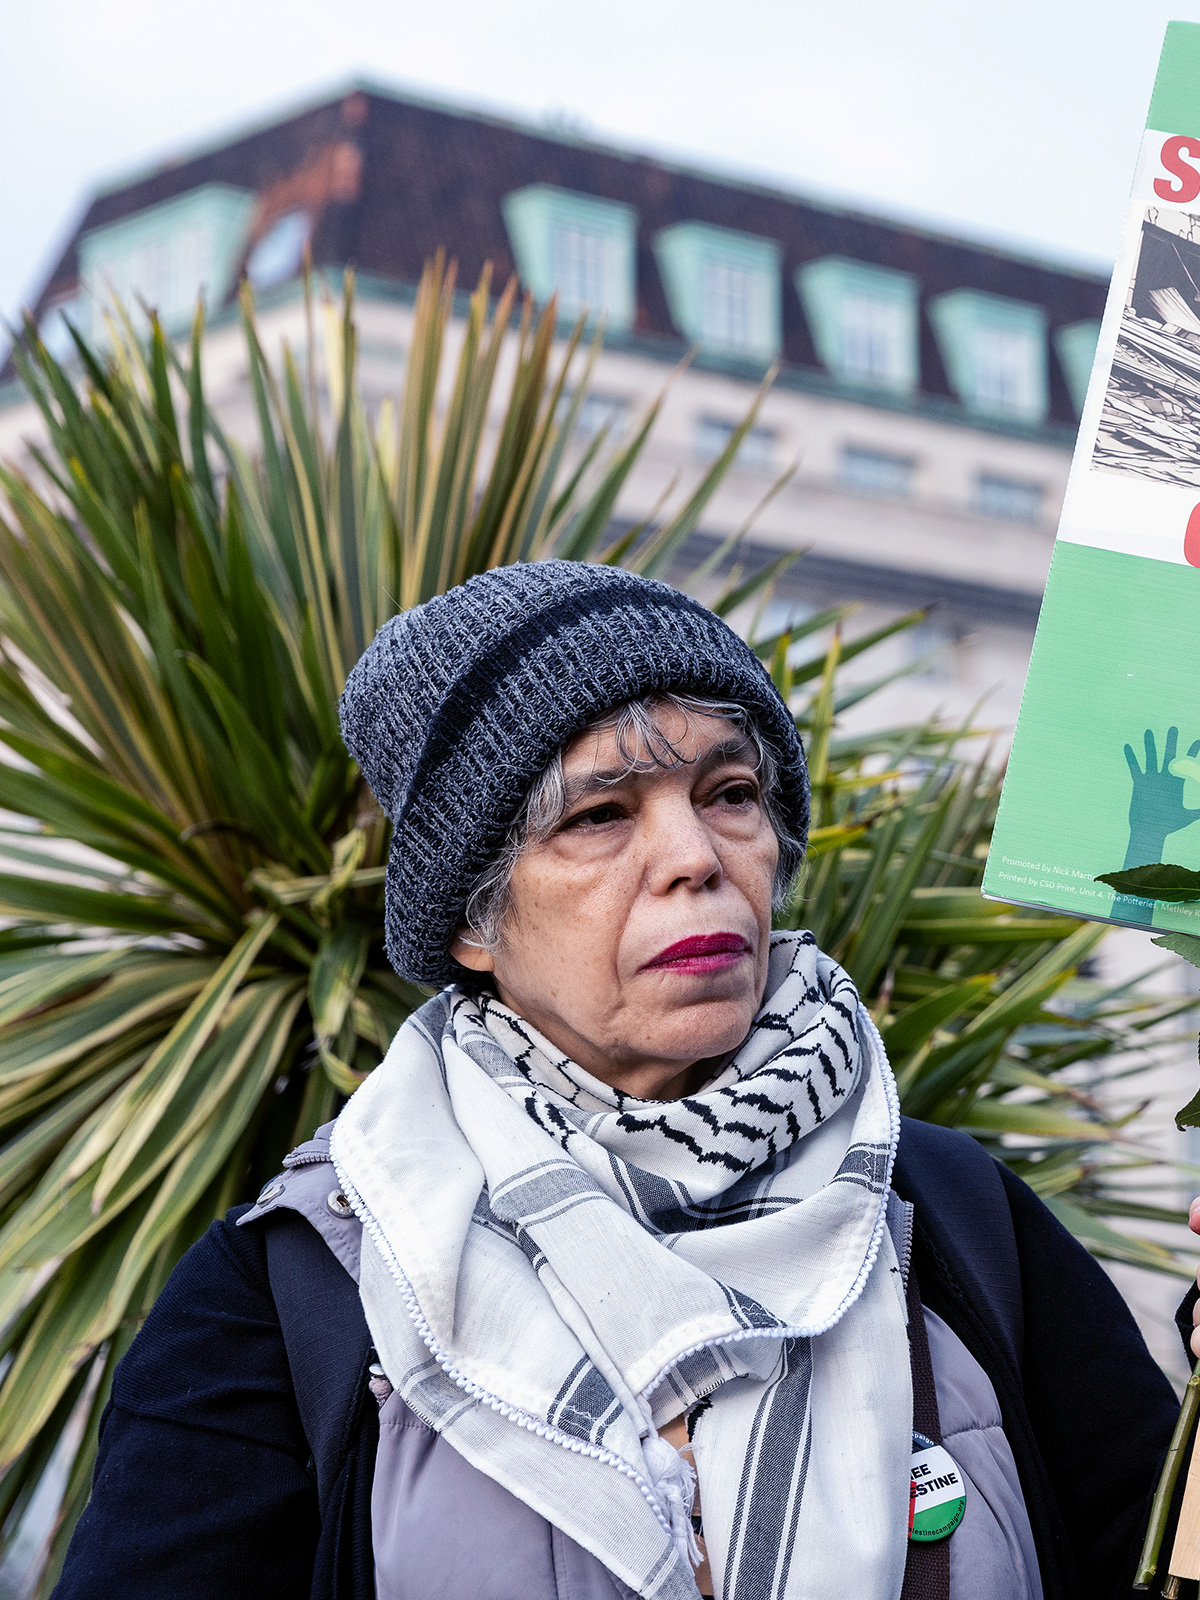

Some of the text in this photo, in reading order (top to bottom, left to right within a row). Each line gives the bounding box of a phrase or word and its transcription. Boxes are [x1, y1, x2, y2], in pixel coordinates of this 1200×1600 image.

[1001, 856, 1041, 871] Promoted
[1042, 863, 1051, 874] by
[1053, 866, 1070, 876] Nick
[998, 871, 1027, 883] Printed
[1028, 876, 1038, 887] by
[1039, 879, 1055, 889] CSD
[1056, 882, 1077, 895] Print,
[1079, 887, 1096, 897] Unit
[1107, 892, 1121, 902] The
[1160, 903, 1193, 917] Methley
[911, 1464, 932, 1480] EE
